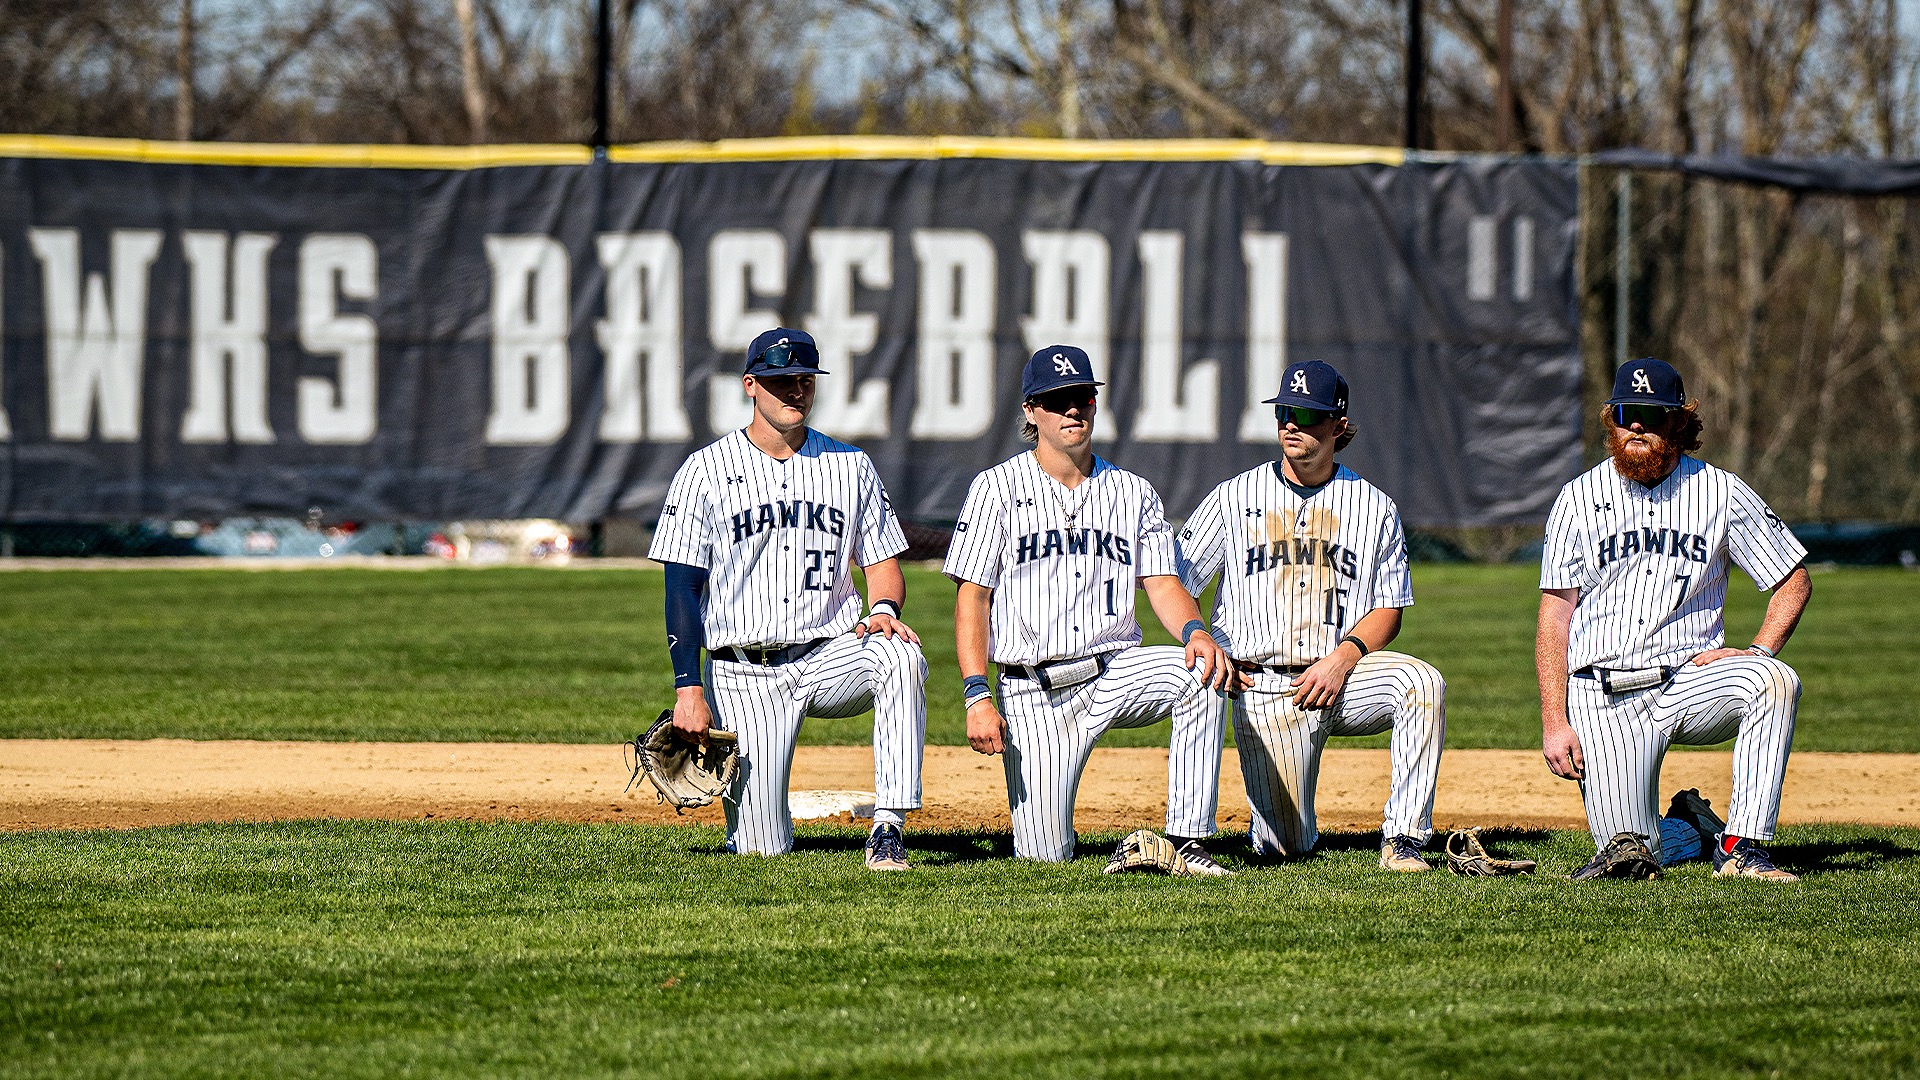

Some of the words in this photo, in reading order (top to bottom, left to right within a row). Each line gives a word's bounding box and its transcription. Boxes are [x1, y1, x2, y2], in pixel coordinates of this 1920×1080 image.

[0, 226, 379, 444] WKS
[484, 228, 1289, 446] BASEBALL
[1052, 353, 1079, 376] SA
[1290, 369, 1311, 395] SA
[1631, 368, 1654, 394] SA
[731, 500, 845, 546] HAWKS
[1016, 528, 1132, 566] HAWKS
[1245, 537, 1358, 580] HAWKS
[1599, 527, 1707, 568] HAWKS
[804, 549, 836, 591] 23
[1103, 577, 1117, 616] 1
[1674, 574, 1690, 612] 7
